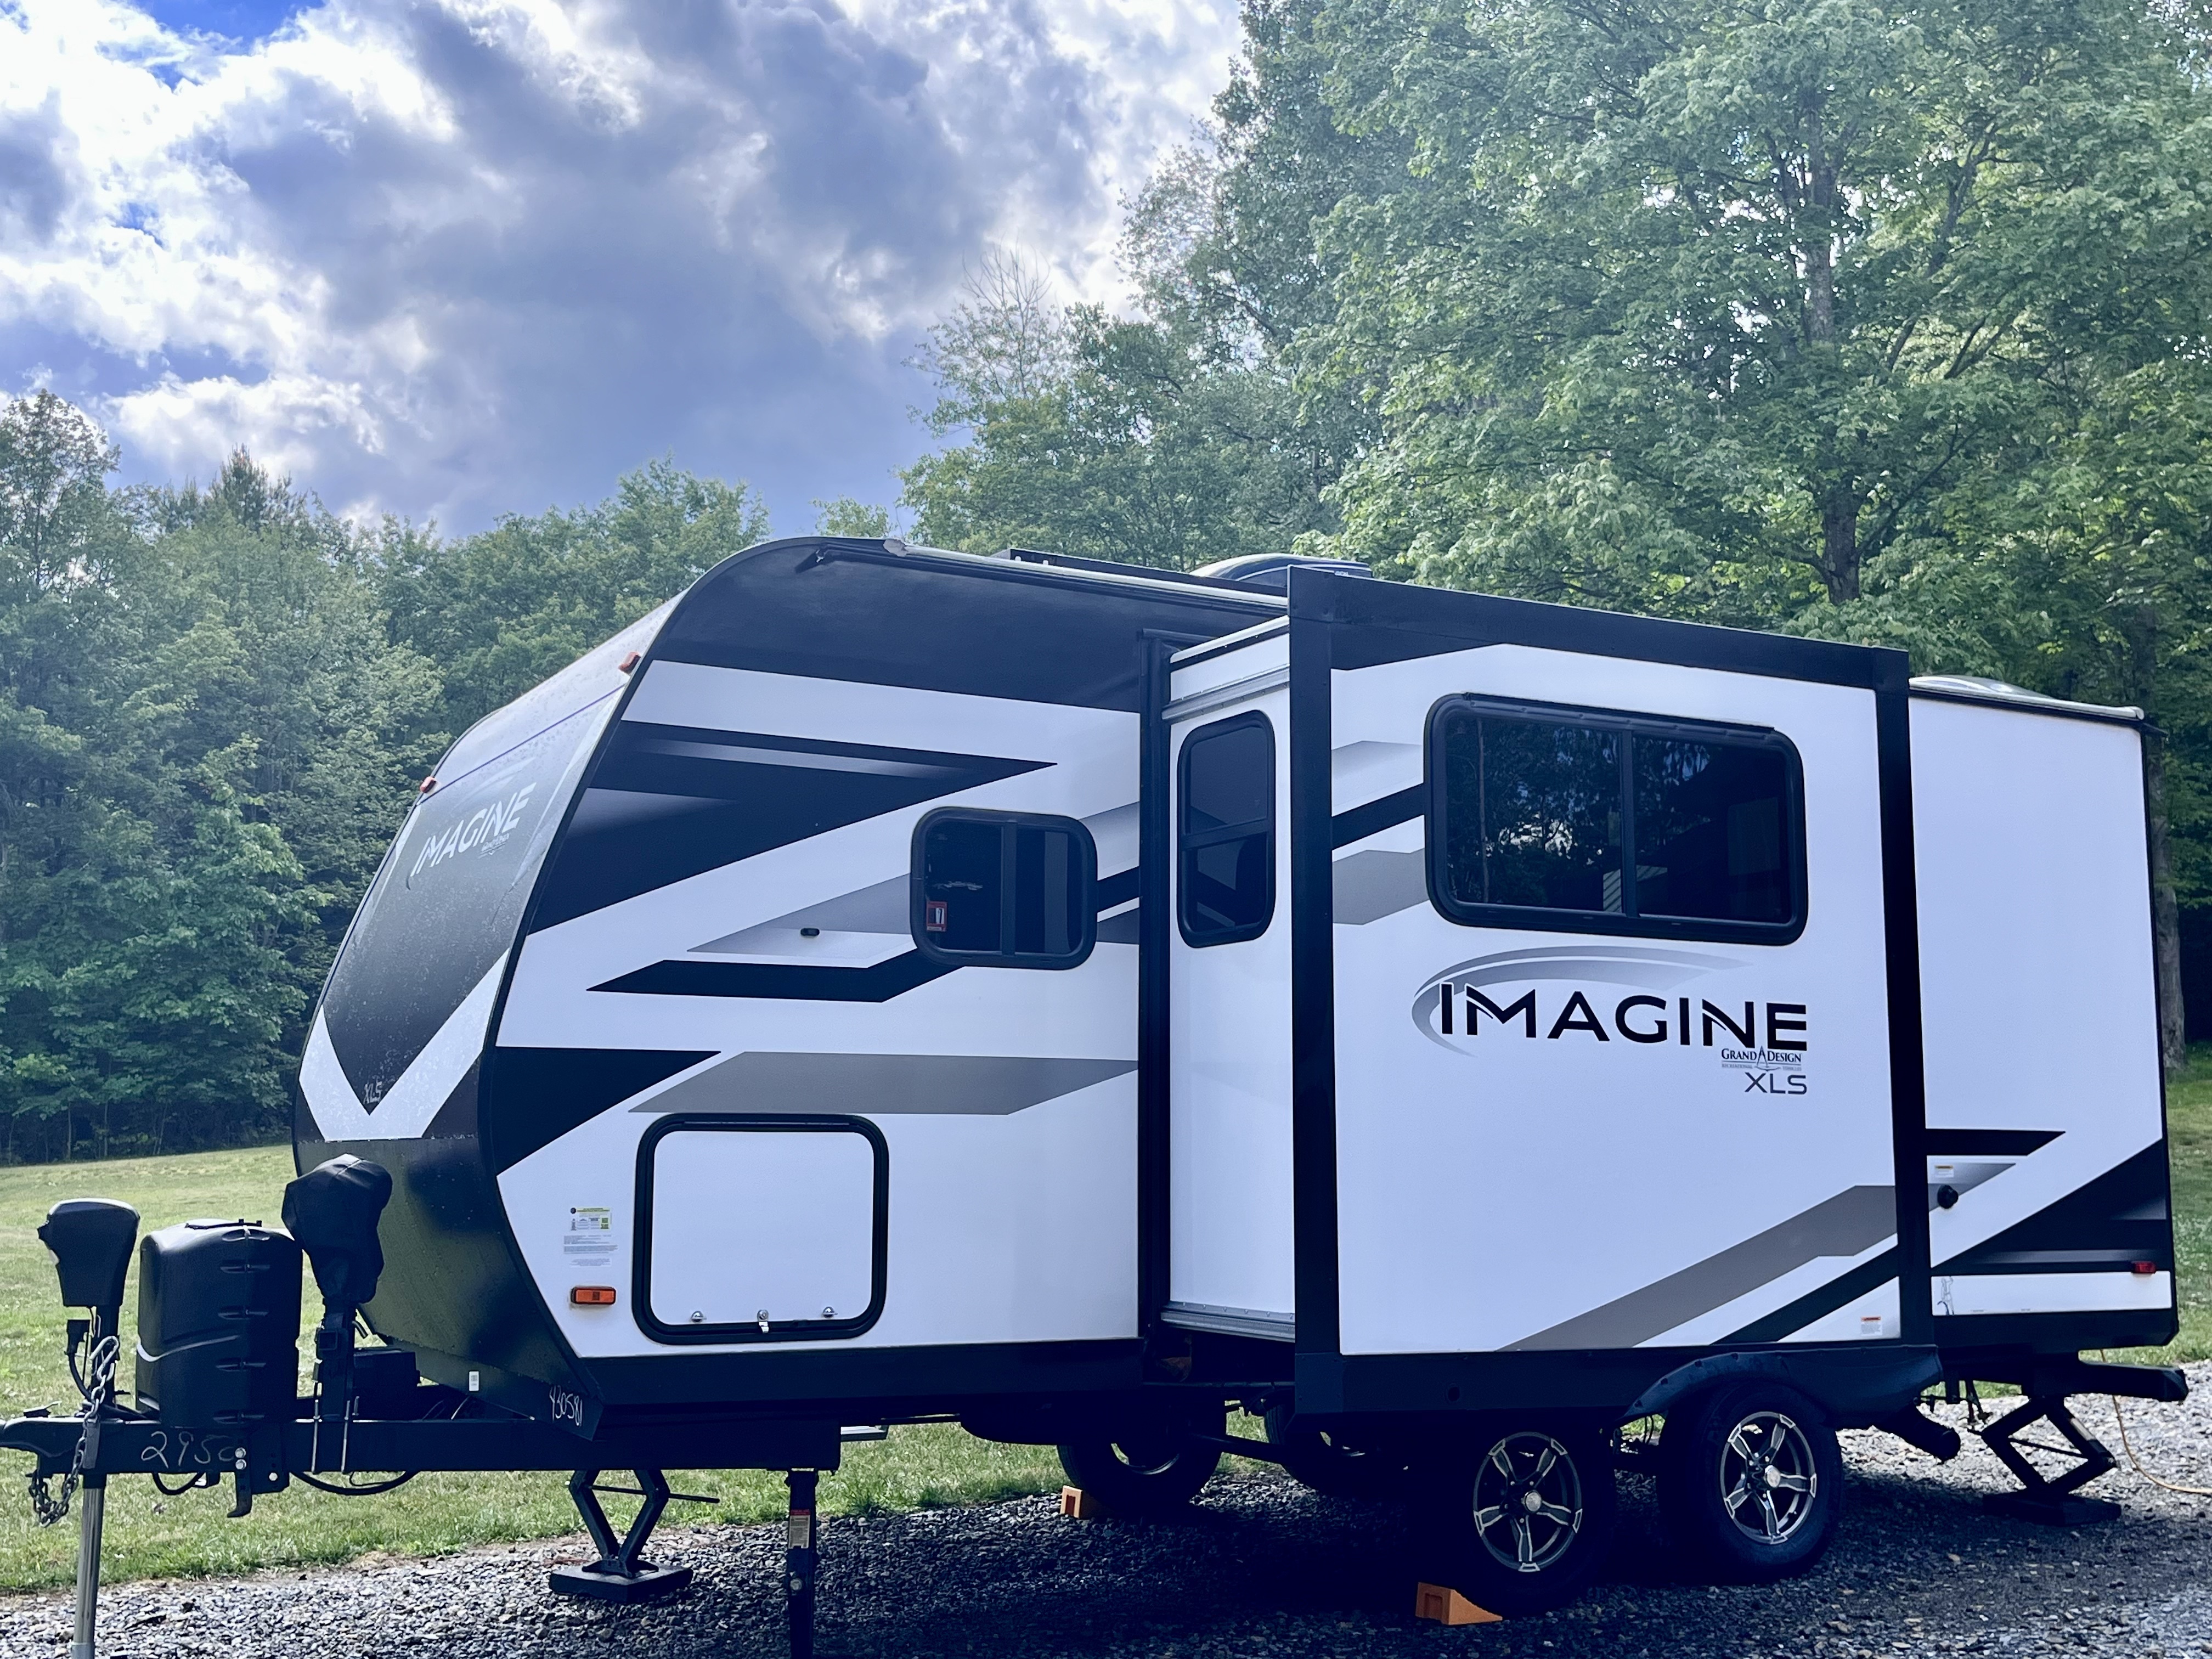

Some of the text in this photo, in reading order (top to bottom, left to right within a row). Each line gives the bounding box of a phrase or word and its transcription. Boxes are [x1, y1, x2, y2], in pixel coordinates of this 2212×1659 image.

[410, 782, 537, 877] IMAGINE
[1441, 984, 1807, 1051] IMAGINE
[1722, 1048, 1801, 1063] GRAND DESIGN
[1745, 1072, 1807, 1094] XLS
